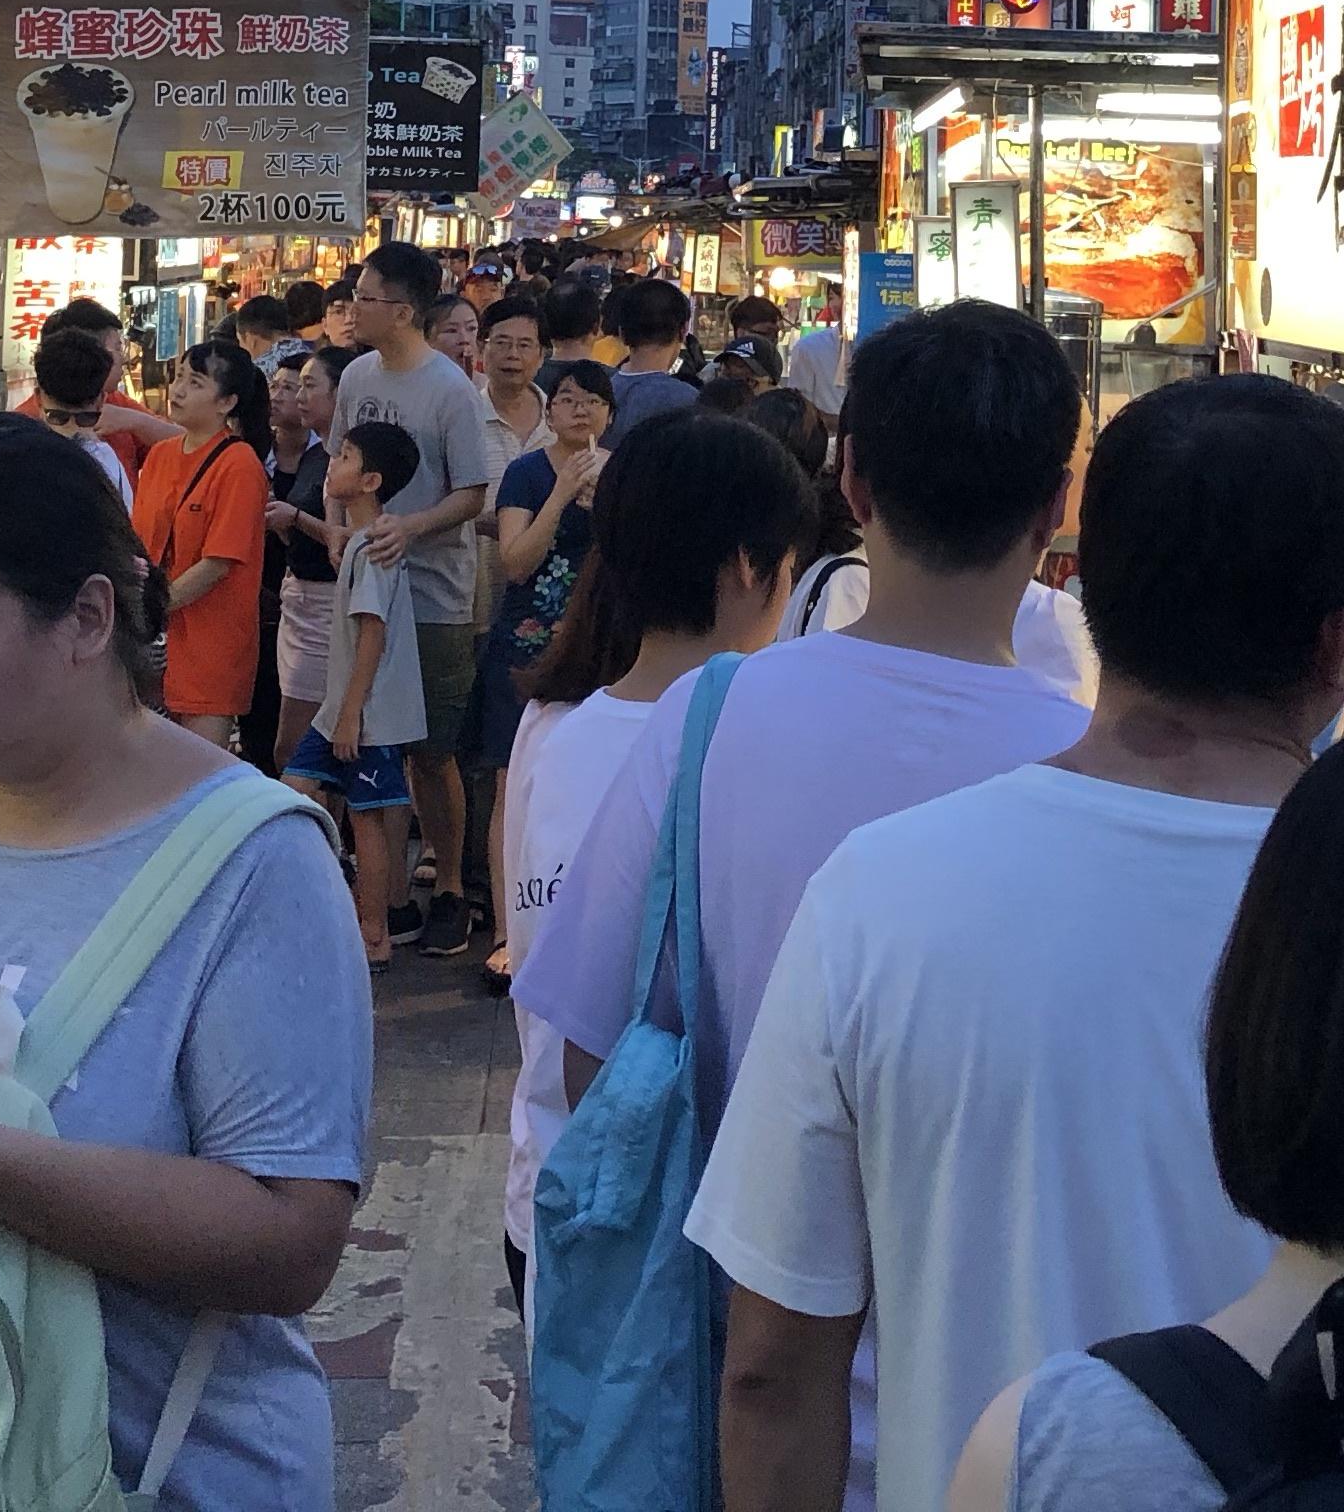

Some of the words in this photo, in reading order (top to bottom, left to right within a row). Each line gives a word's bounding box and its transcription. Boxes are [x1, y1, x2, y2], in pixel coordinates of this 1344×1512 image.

[15, 7, 224, 60] 蜂蜜珍珠
[236, 14, 351, 54] 鮮奶茶
[380, 67, 420, 83] Tea
[156, 81, 226, 106] Pearl
[236, 80, 295, 106] milk
[304, 84, 349, 107] tea
[202, 117, 348, 142] パールティー
[263, 152, 343, 179] 진주차
[402, 147, 433, 159] Milk
[437, 147, 462, 159] Tea
[177, 156, 231, 186] 特價
[199, 191, 346, 224] 2杯100元
